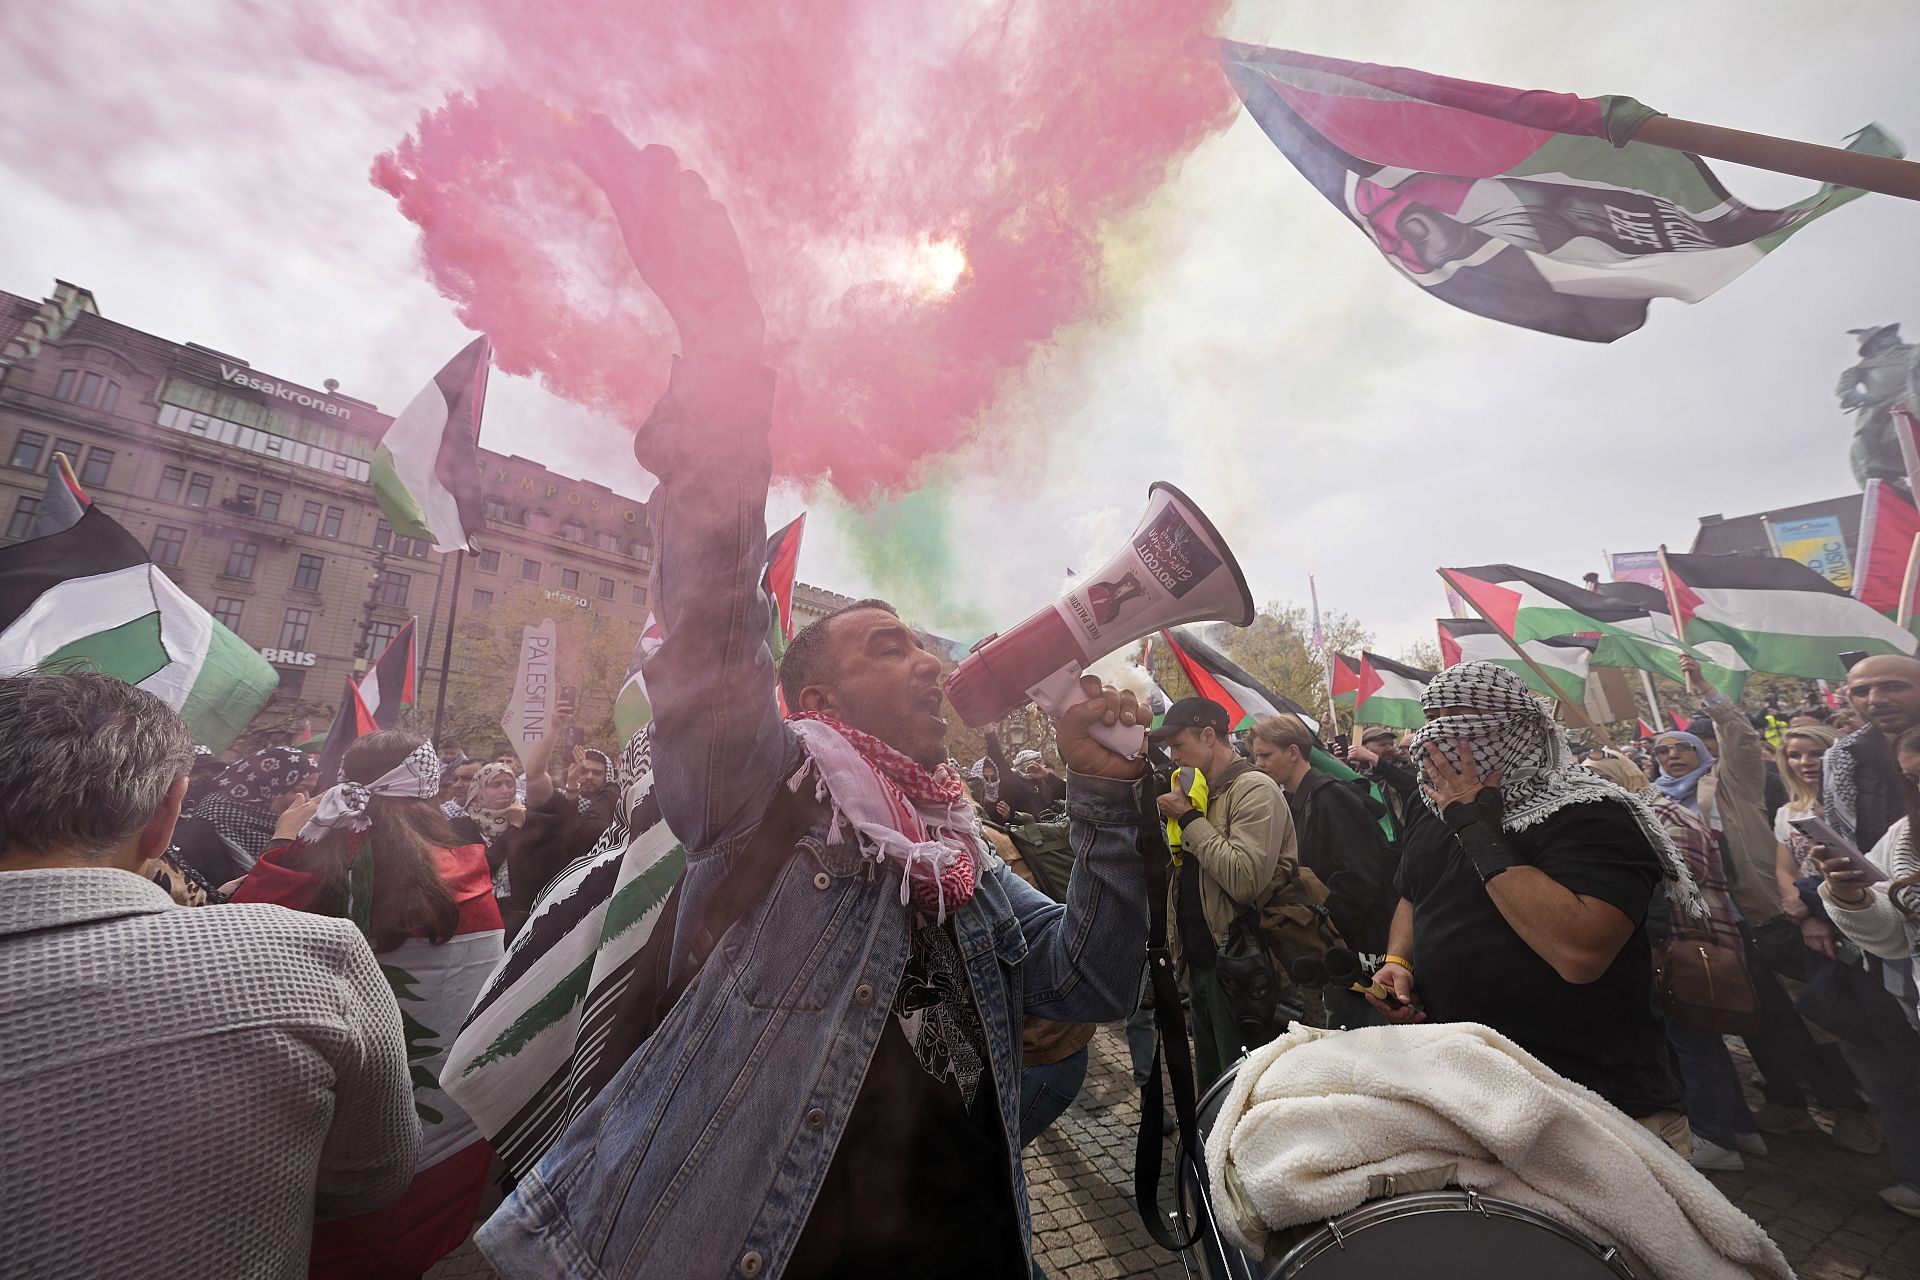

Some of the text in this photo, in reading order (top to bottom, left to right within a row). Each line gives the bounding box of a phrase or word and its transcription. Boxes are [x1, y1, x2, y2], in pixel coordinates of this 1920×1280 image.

[220, 364, 350, 420] Vasakronan
[1137, 544, 1177, 590] BOYCOTT
[1823, 542, 1850, 581] MUSIC
[1086, 622, 1102, 640] FREE
[261, 648, 317, 666] BRIS
[523, 636, 549, 742] PALESTINE
